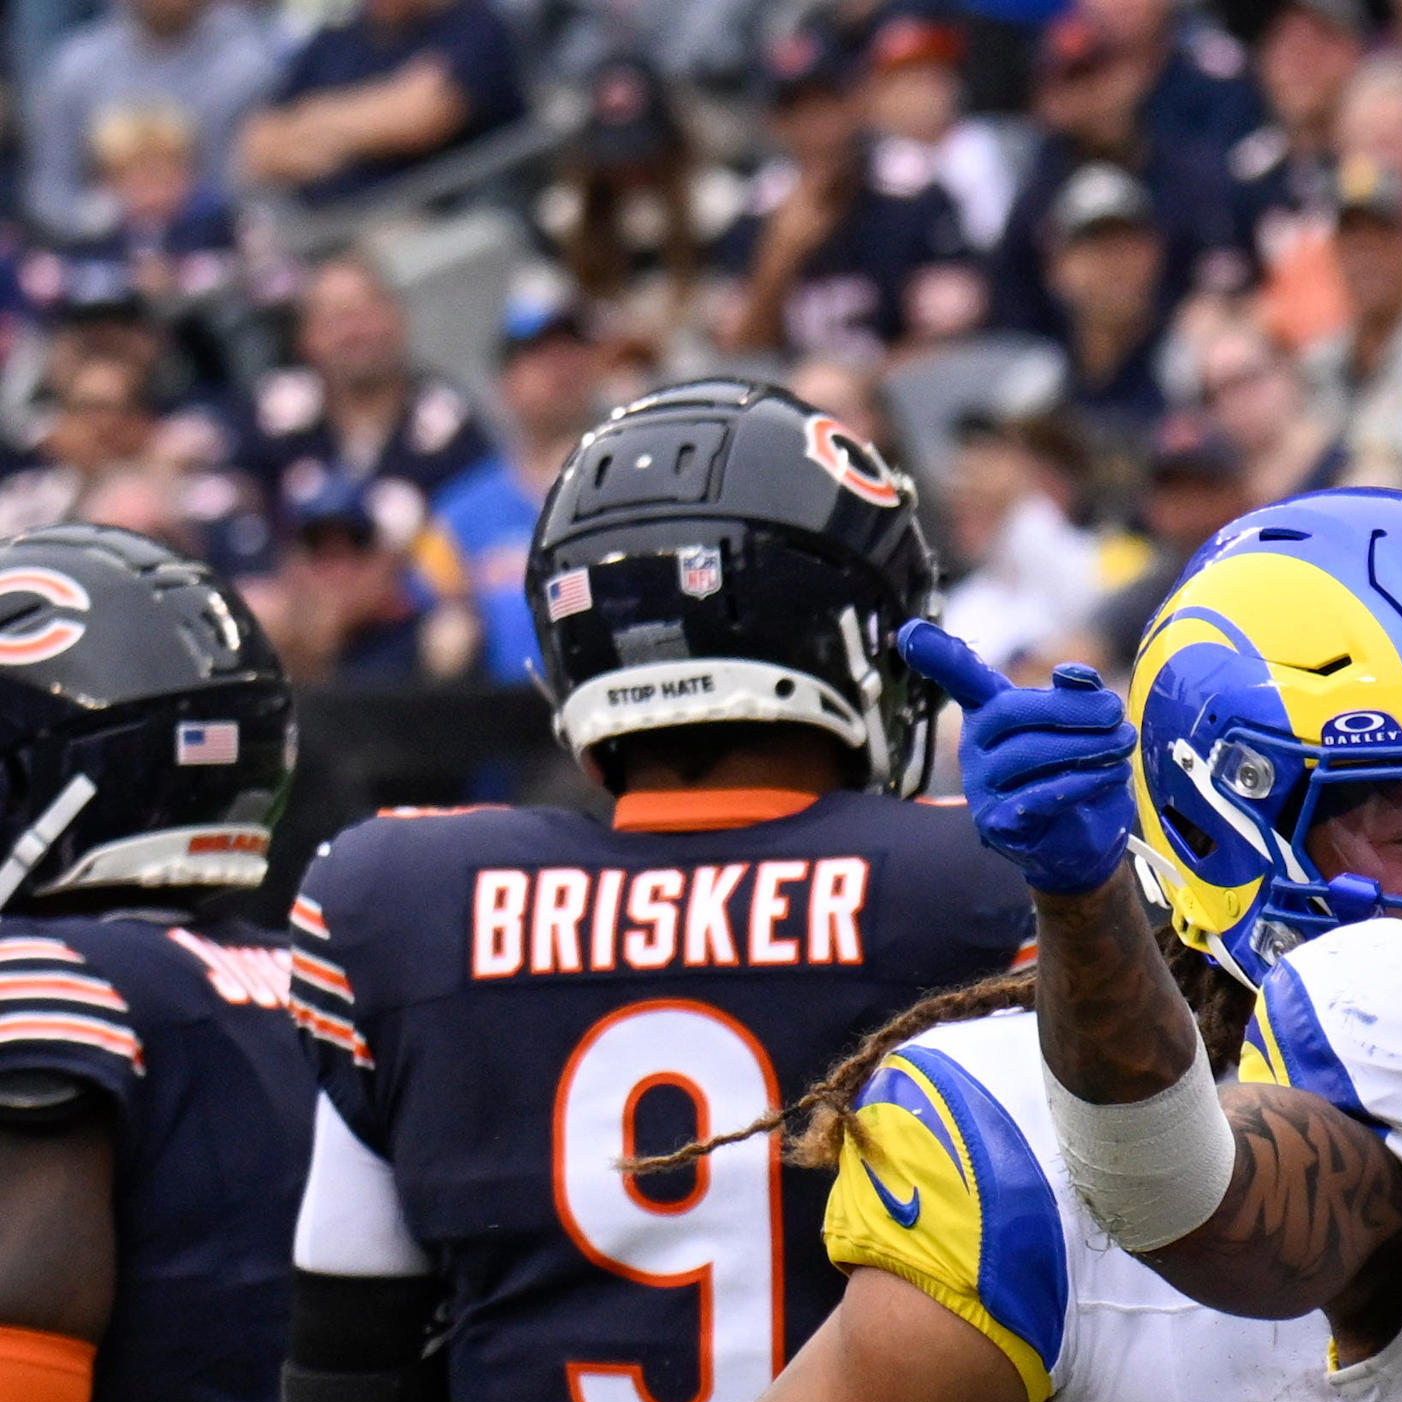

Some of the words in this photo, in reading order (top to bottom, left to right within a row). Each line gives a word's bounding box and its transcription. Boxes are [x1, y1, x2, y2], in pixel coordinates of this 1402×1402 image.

[607, 685, 655, 706] STOP
[660, 674, 715, 700] HATE
[1323, 730, 1400, 746] OAKLEY
[471, 855, 870, 981] BRISKER
